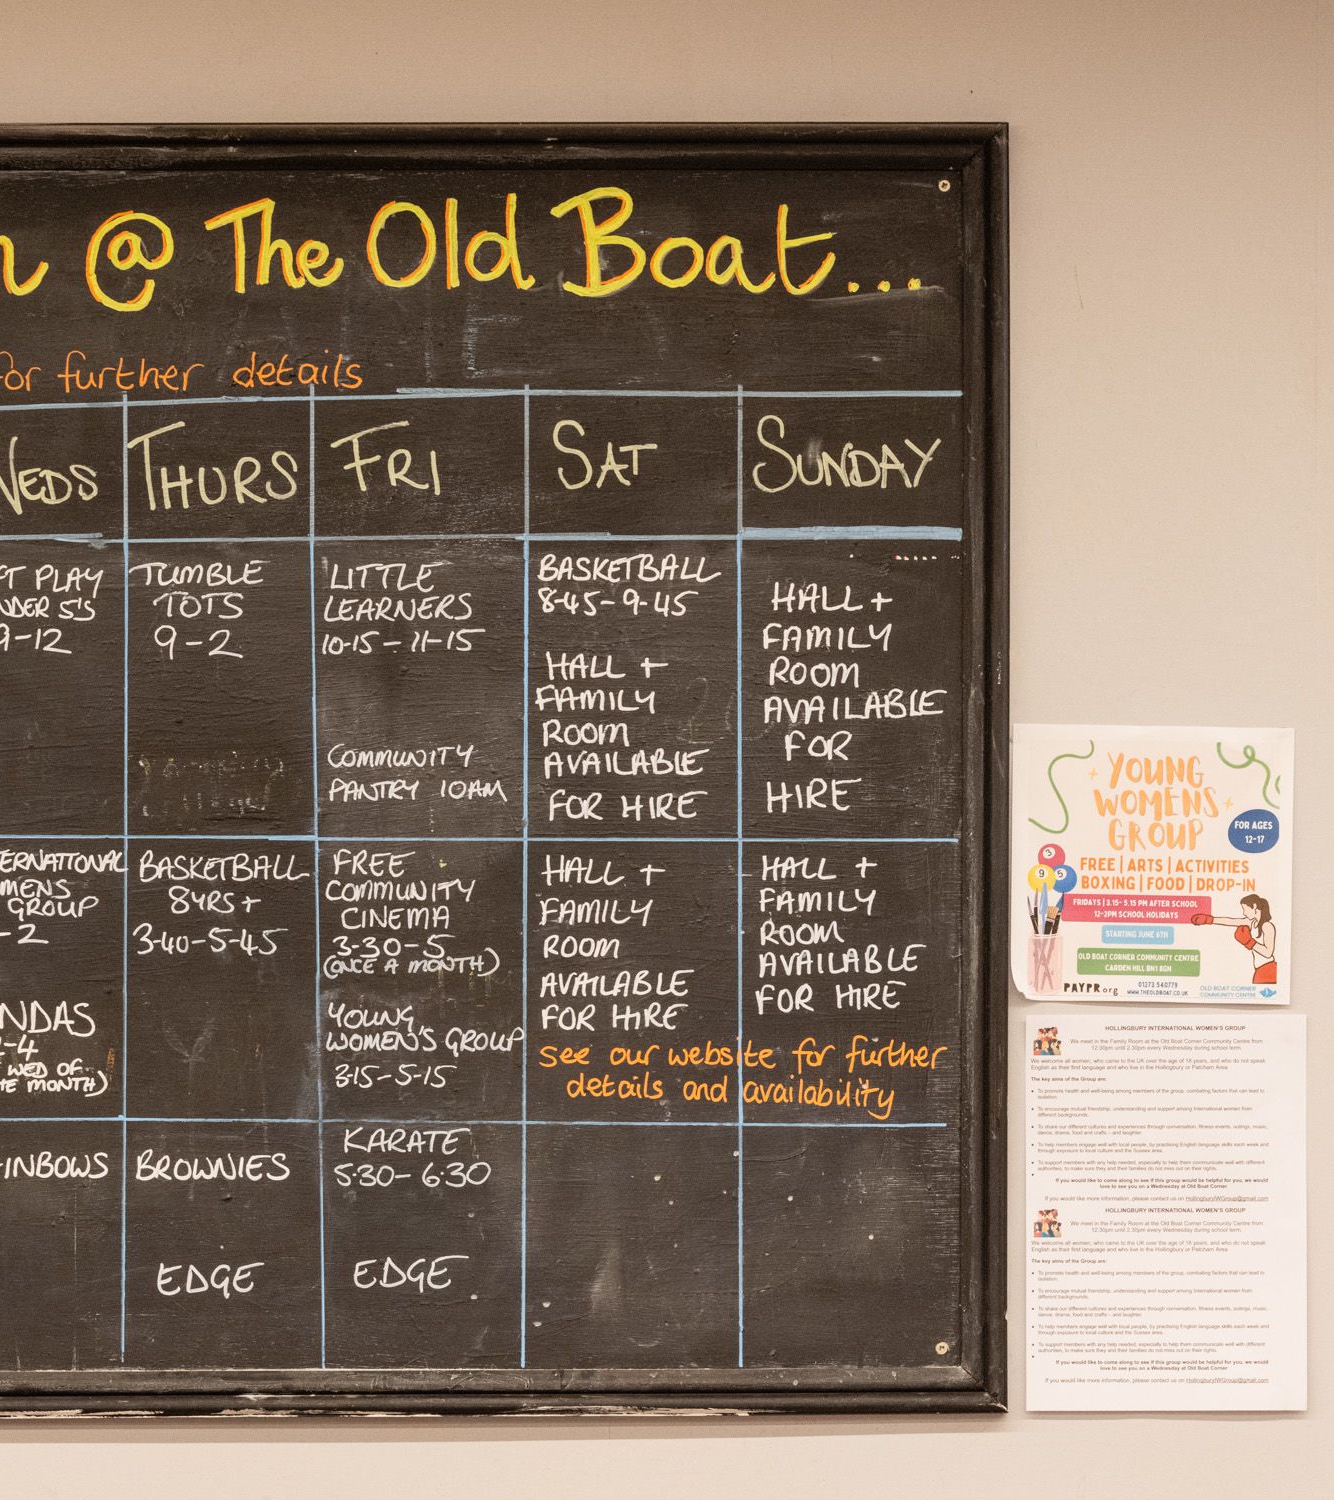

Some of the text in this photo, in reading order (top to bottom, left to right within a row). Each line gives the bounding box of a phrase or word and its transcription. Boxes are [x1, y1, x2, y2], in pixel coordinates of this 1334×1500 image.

[87, 211, 175, 312] @
[205, 198, 344, 293] The
[366, 192, 536, 291] Old
[58, 349, 204, 394] further
[231, 348, 363, 390] details
[35, 563, 104, 598] PLAY
[129, 559, 271, 587] TUMBLE
[330, 561, 454, 593] LITTLE
[153, 590, 244, 620] TOTS
[323, 592, 473, 623] LEARNERS
[326, 743, 477, 769] COMMUNITY
[1107, 751, 1207, 789] YOUNG
[328, 779, 508, 803] PANTRY 10AM
[1093, 785, 1220, 822] WOMENS
[1107, 817, 1205, 853] GROUP
[1234, 820, 1274, 831] FOR AGES
[1244, 834, 1266, 845] 12-17
[138, 848, 311, 883] BASKETBALL
[332, 848, 417, 878] FREE
[1045, 848, 1054, 858] 3
[1079, 856, 1250, 874] FREE ARTS ACTIVITIES
[1038, 868, 1046, 878] 9
[1056, 869, 1064, 879] 5
[1080, 875, 1257, 893] BOXING FOOD DROP-IN
[325, 878, 478, 904] COMMUNITY
[6, 895, 100, 922] GROUP
[340, 905, 451, 932] CINEMA
[609, 1043, 662, 1067] our
[668, 1039, 777, 1070] website
[792, 1036, 837, 1075] for
[844, 1034, 948, 1071] further
[566, 1071, 896, 1122] details and availability
[342, 1126, 471, 1156] KARATE
[134, 1148, 292, 1183] BROWNIES
[156, 1261, 266, 1301] EDGE
